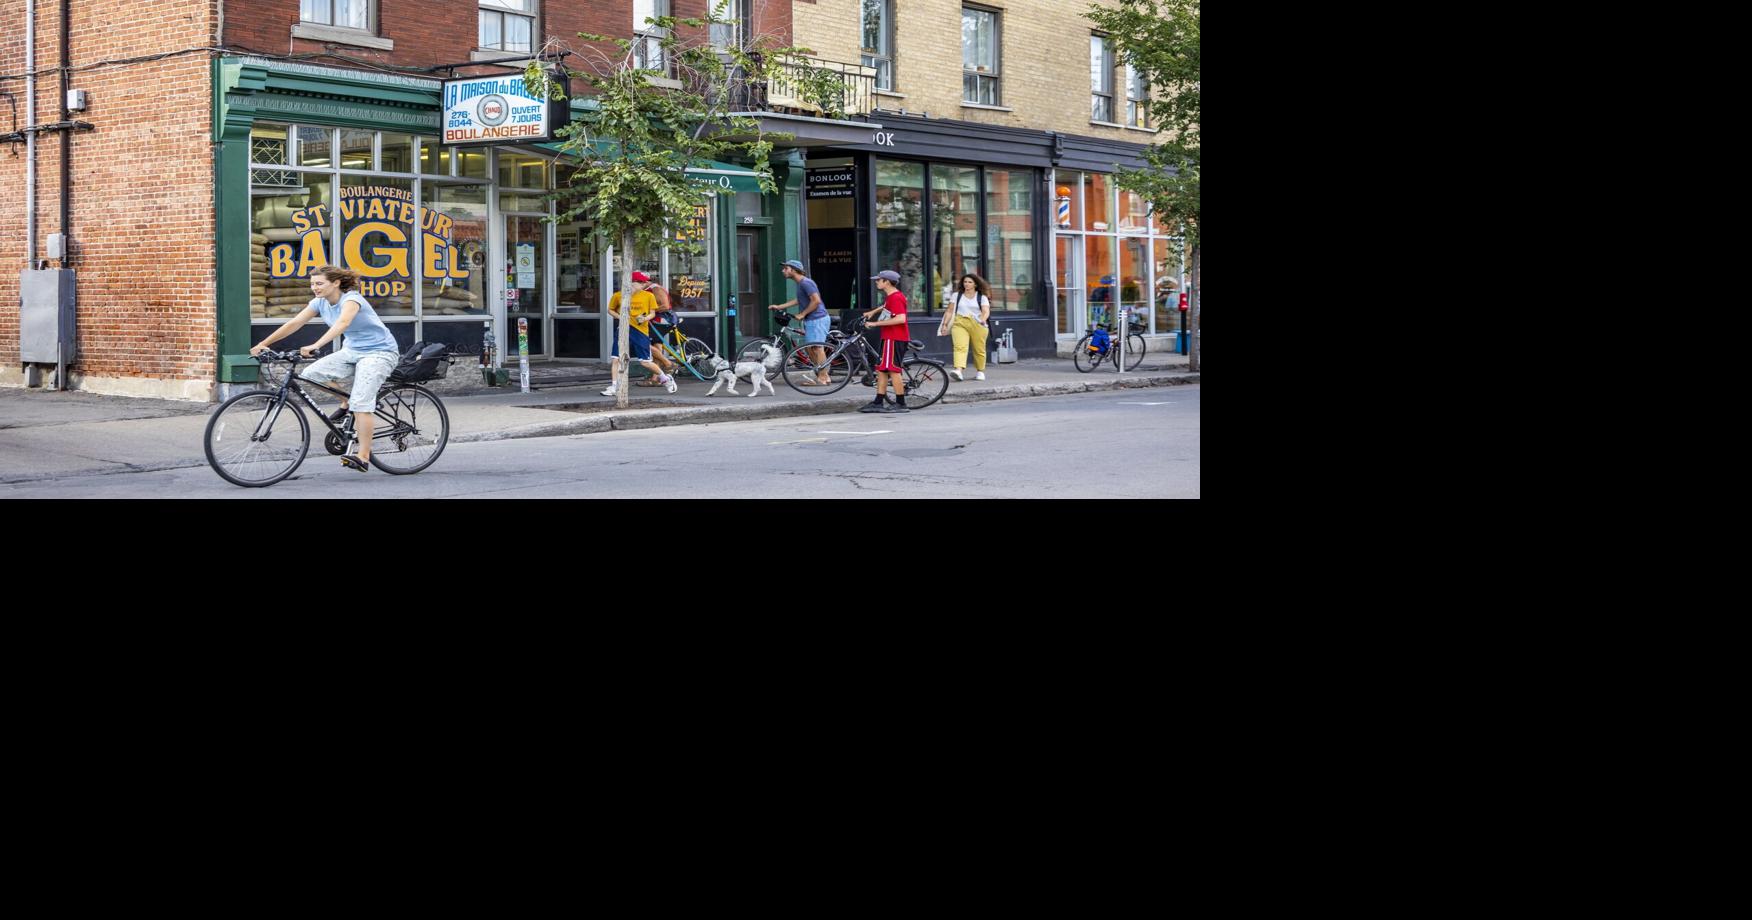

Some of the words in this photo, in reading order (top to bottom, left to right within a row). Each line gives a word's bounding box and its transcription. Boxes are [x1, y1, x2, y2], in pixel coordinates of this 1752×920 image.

[445, 84, 458, 112] LA
[460, 80, 499, 102] MAISON
[500, 81, 509, 94] du
[512, 105, 541, 115] OUVERT
[448, 118, 472, 128] 8044
[446, 124, 540, 140] BOULANGERIE
[809, 173, 852, 182] BONLOOK
[340, 185, 413, 201] BOULANGERIE
[270, 222, 470, 279] BAGEL
[358, 280, 407, 297] HOP
[680, 287, 704, 298] 1957
